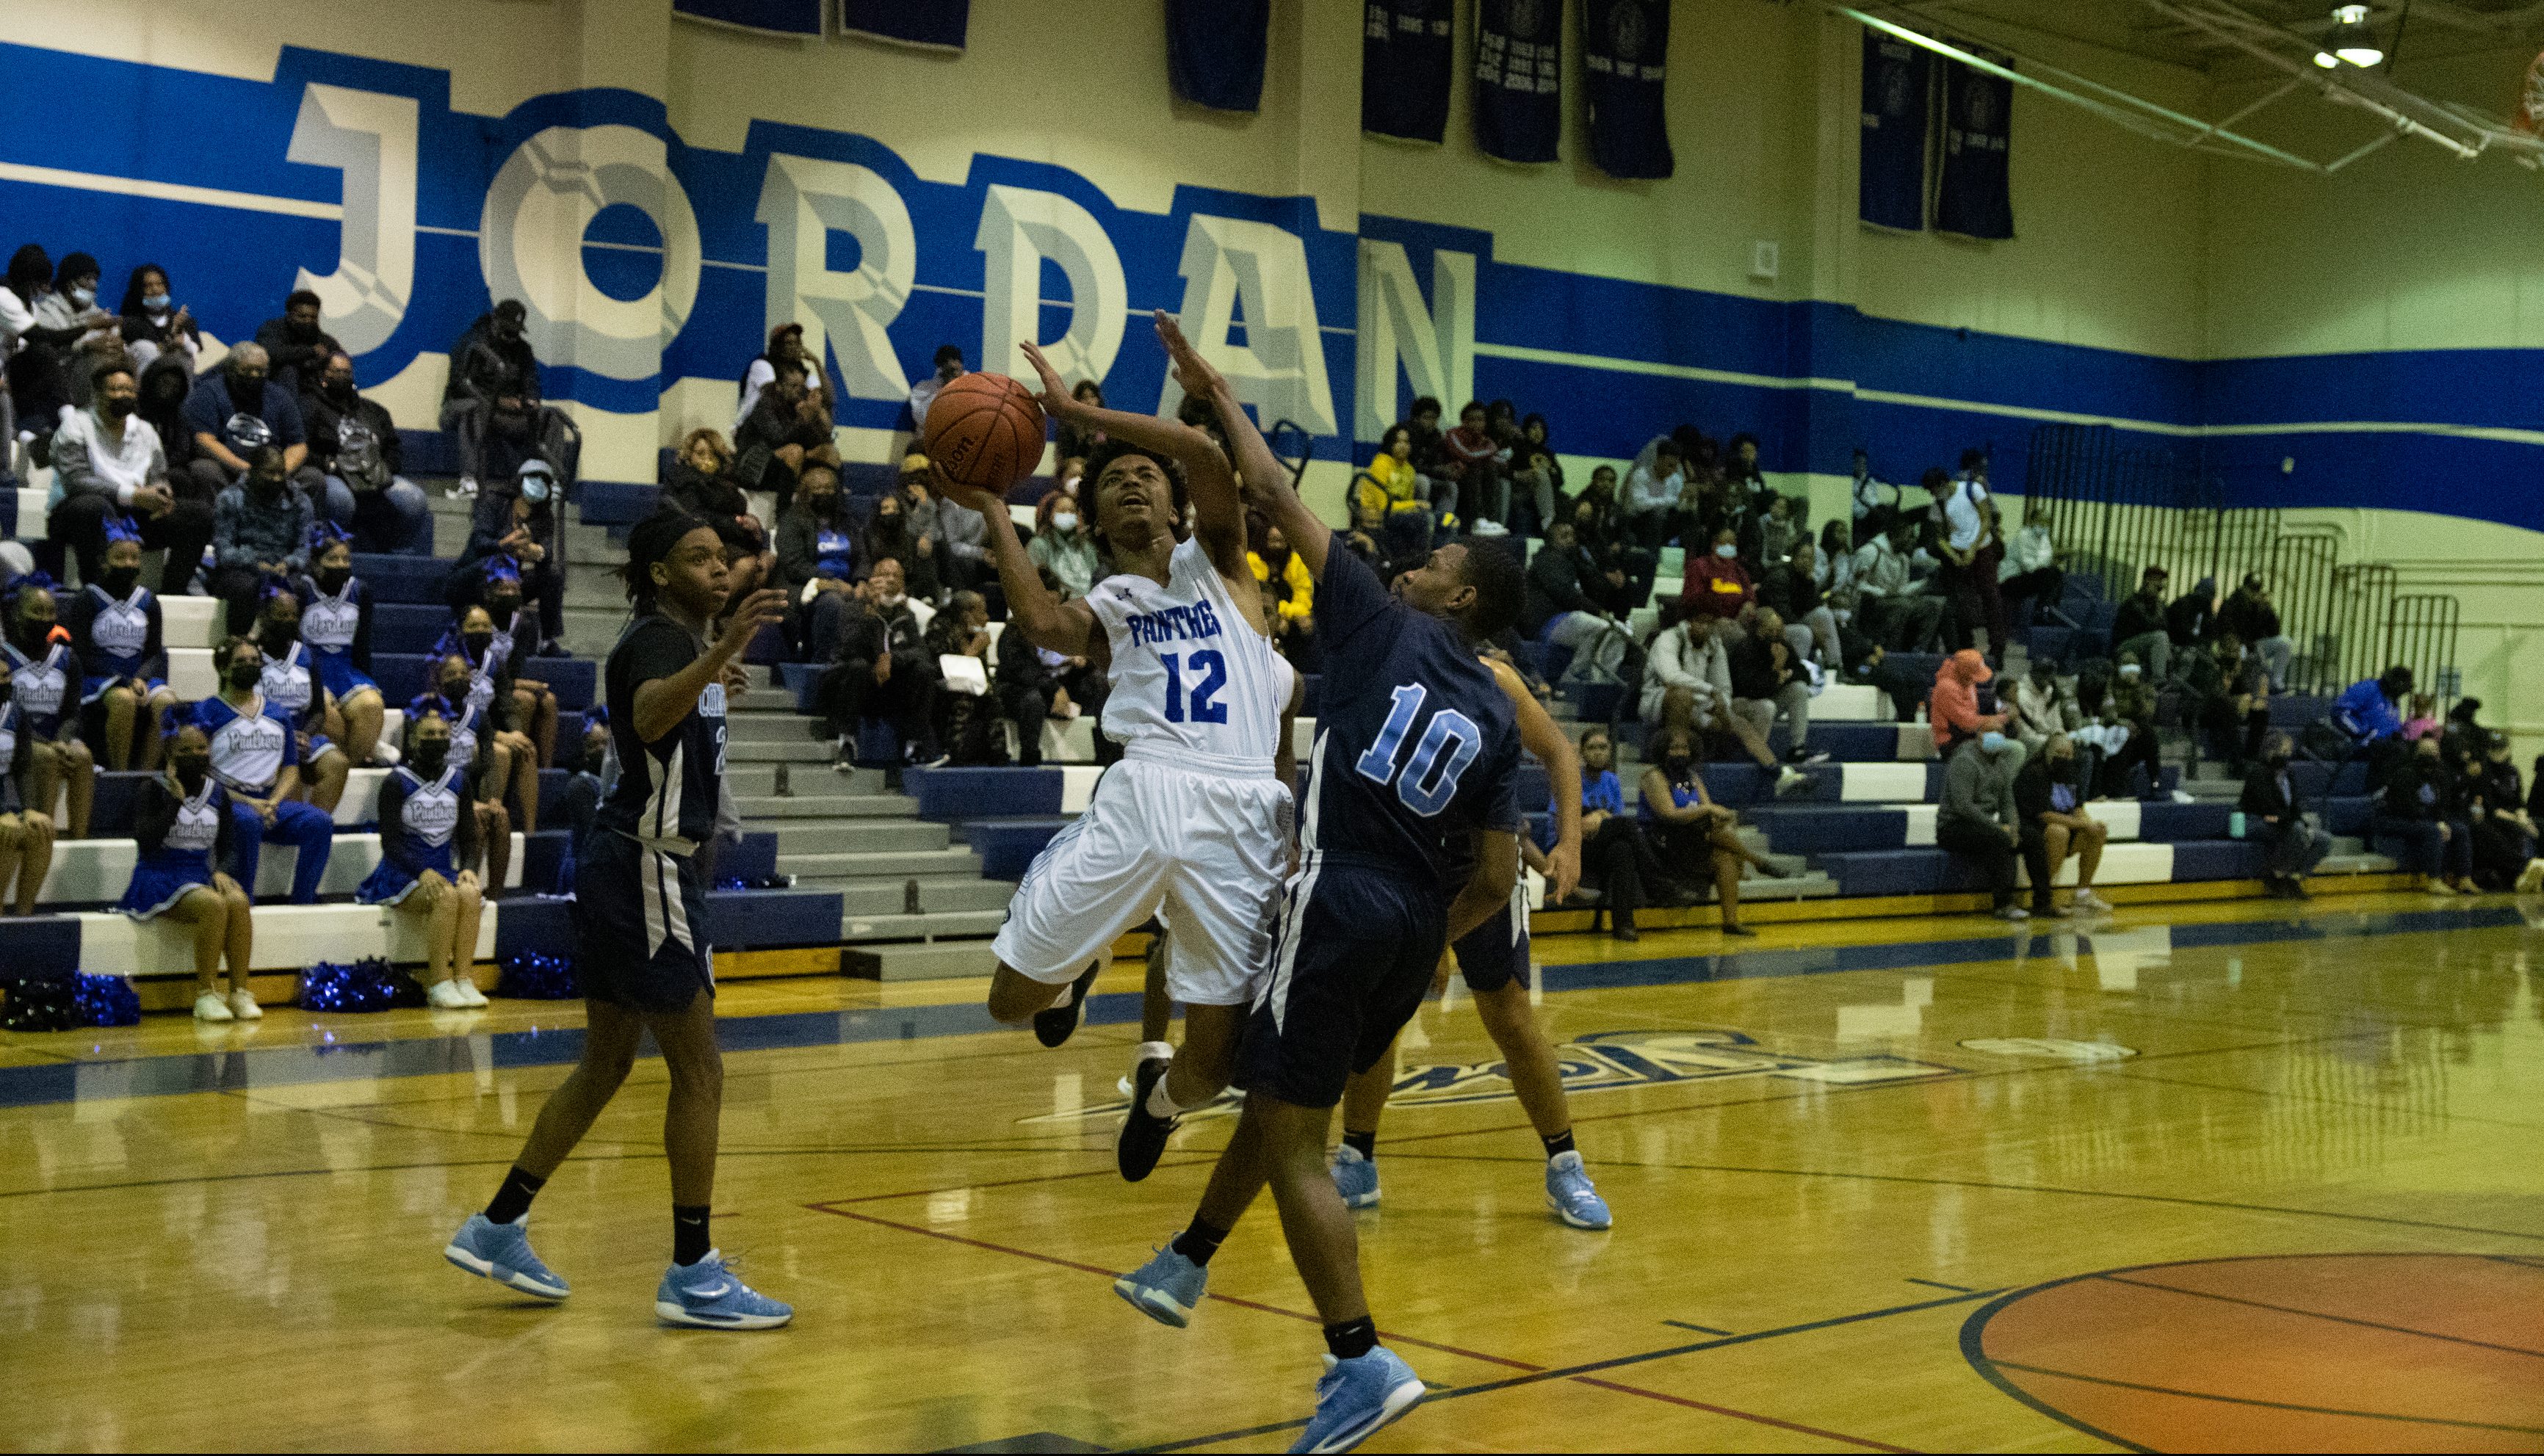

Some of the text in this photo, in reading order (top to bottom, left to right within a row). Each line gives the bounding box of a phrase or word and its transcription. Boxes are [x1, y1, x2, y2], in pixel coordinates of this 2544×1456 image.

[286, 82, 1477, 443] JORDAN
[1160, 649, 1227, 725] 12
[1355, 681, 1482, 817] 10
